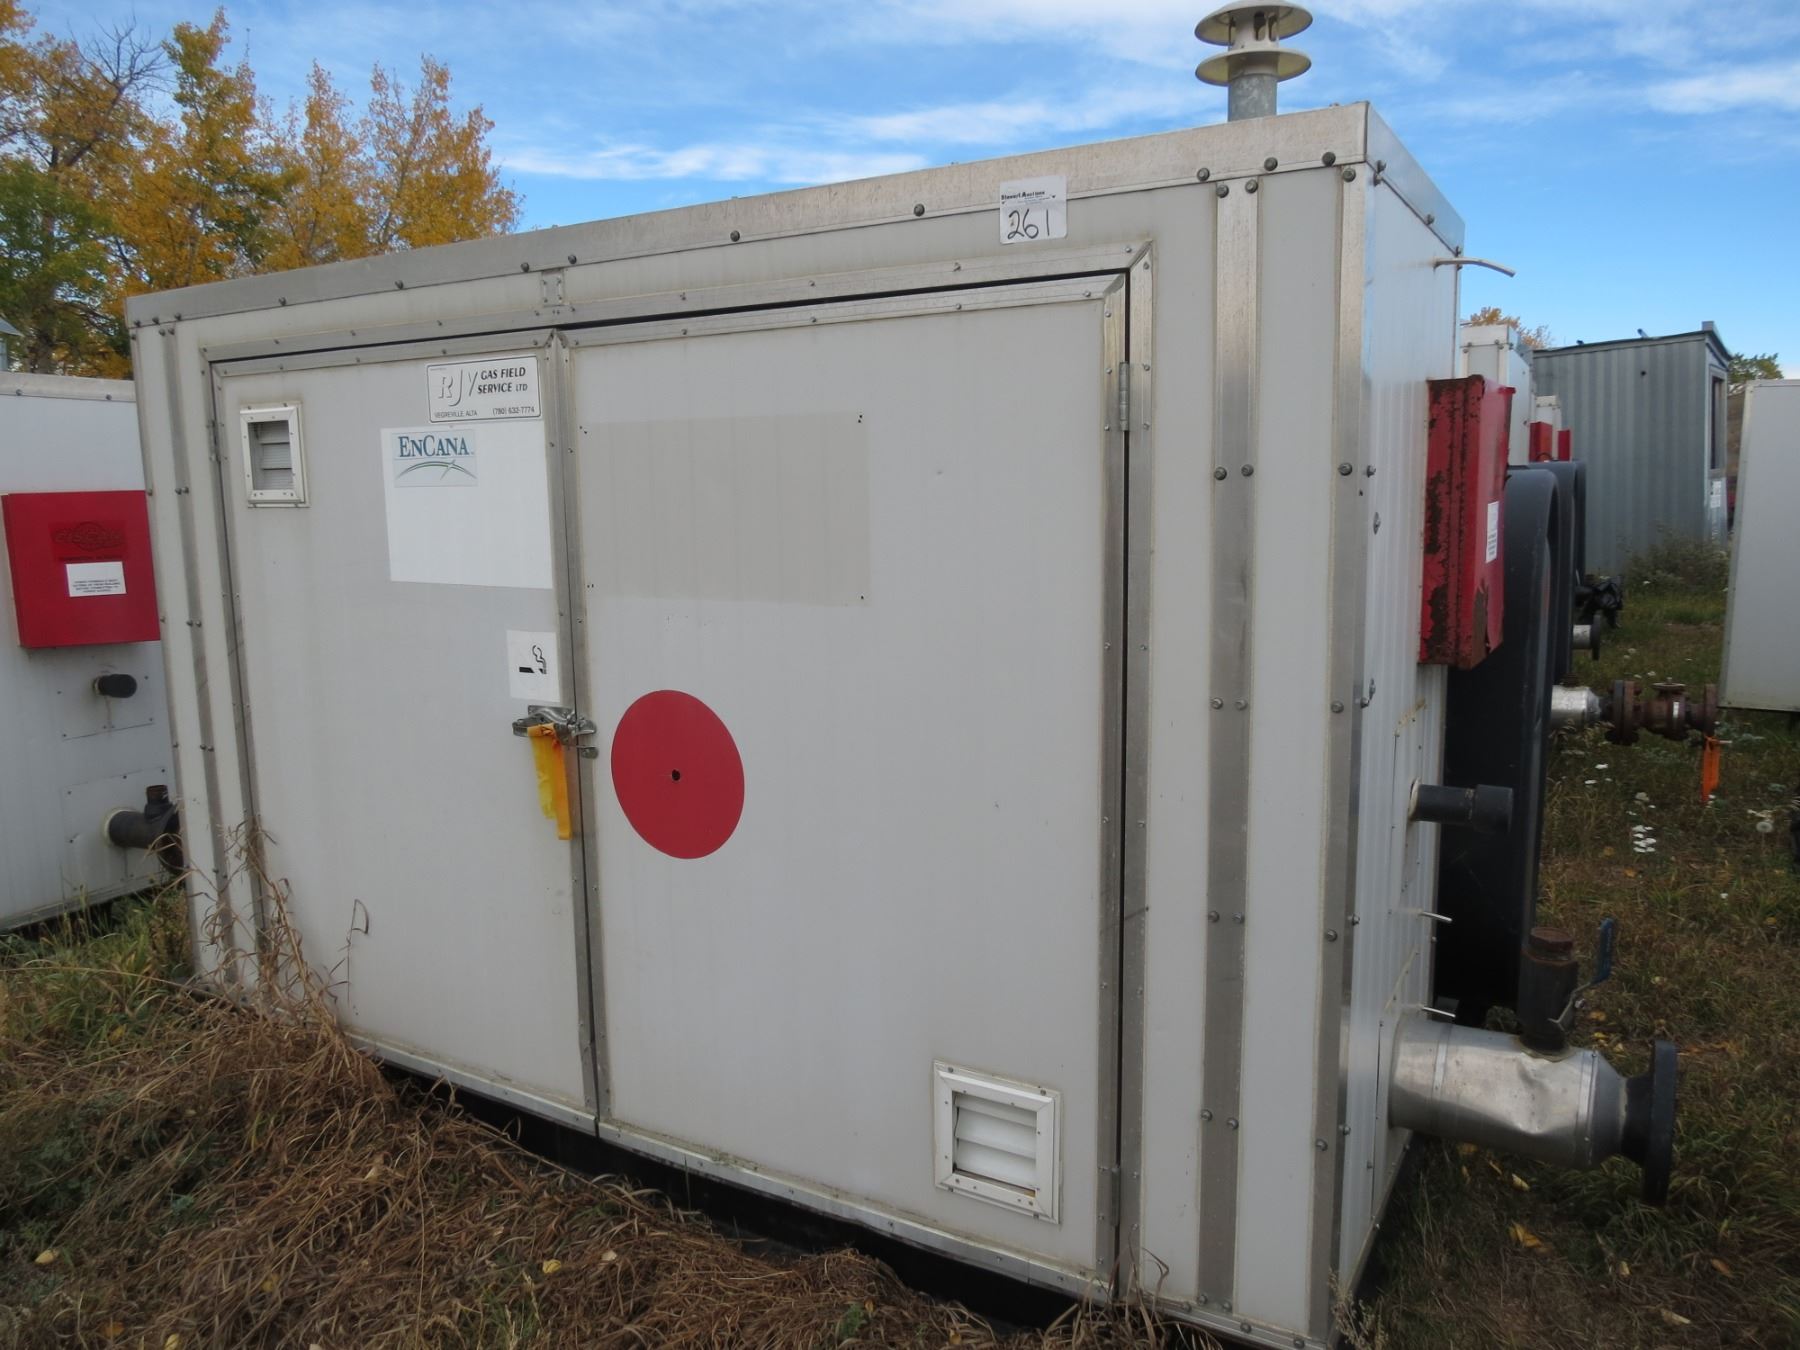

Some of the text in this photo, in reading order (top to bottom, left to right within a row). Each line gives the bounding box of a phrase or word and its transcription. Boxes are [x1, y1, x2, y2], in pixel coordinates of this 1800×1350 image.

[1007, 208, 1050, 239] 261
[480, 366, 526, 380] GAS FIELD
[477, 382, 528, 394] SERVICE LTD
